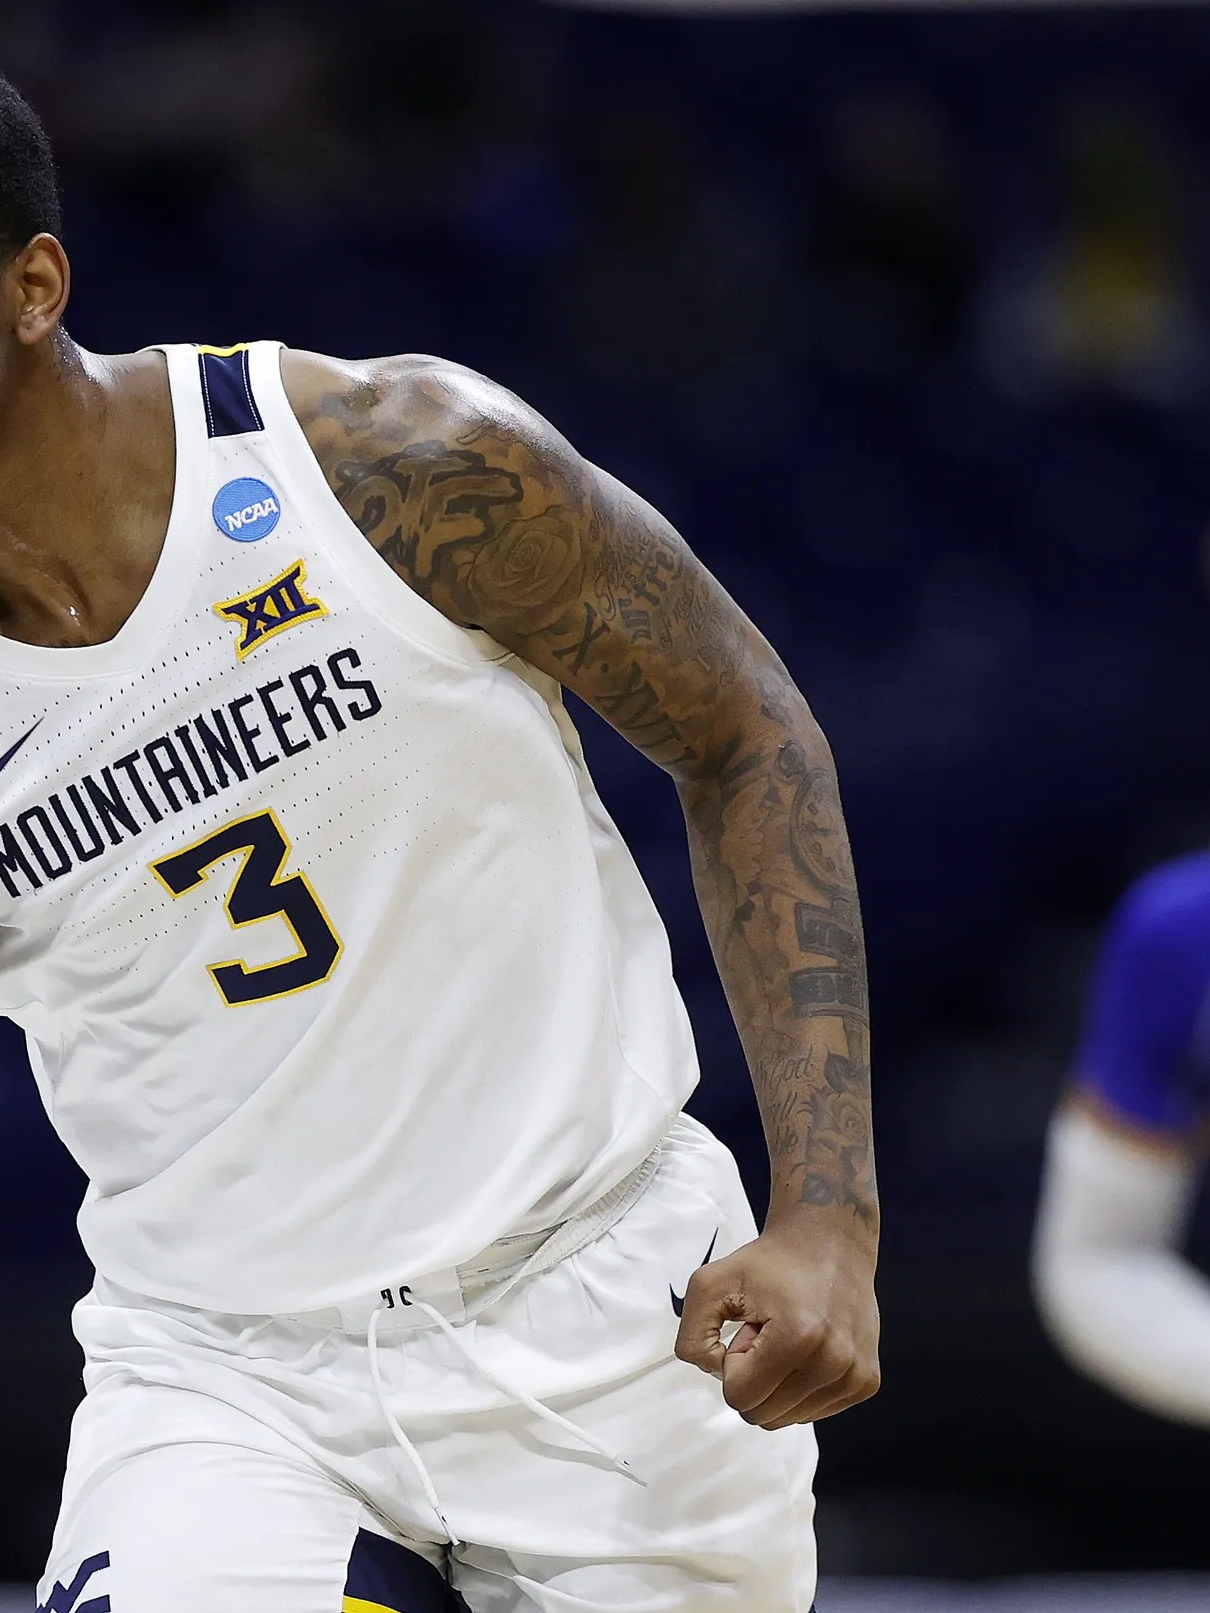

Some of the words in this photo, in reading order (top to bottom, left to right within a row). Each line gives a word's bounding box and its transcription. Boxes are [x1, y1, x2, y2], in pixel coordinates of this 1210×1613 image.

[224, 498, 278, 531] NCAA
[221, 565, 320, 650] XII
[147, 807, 344, 1008] 3
